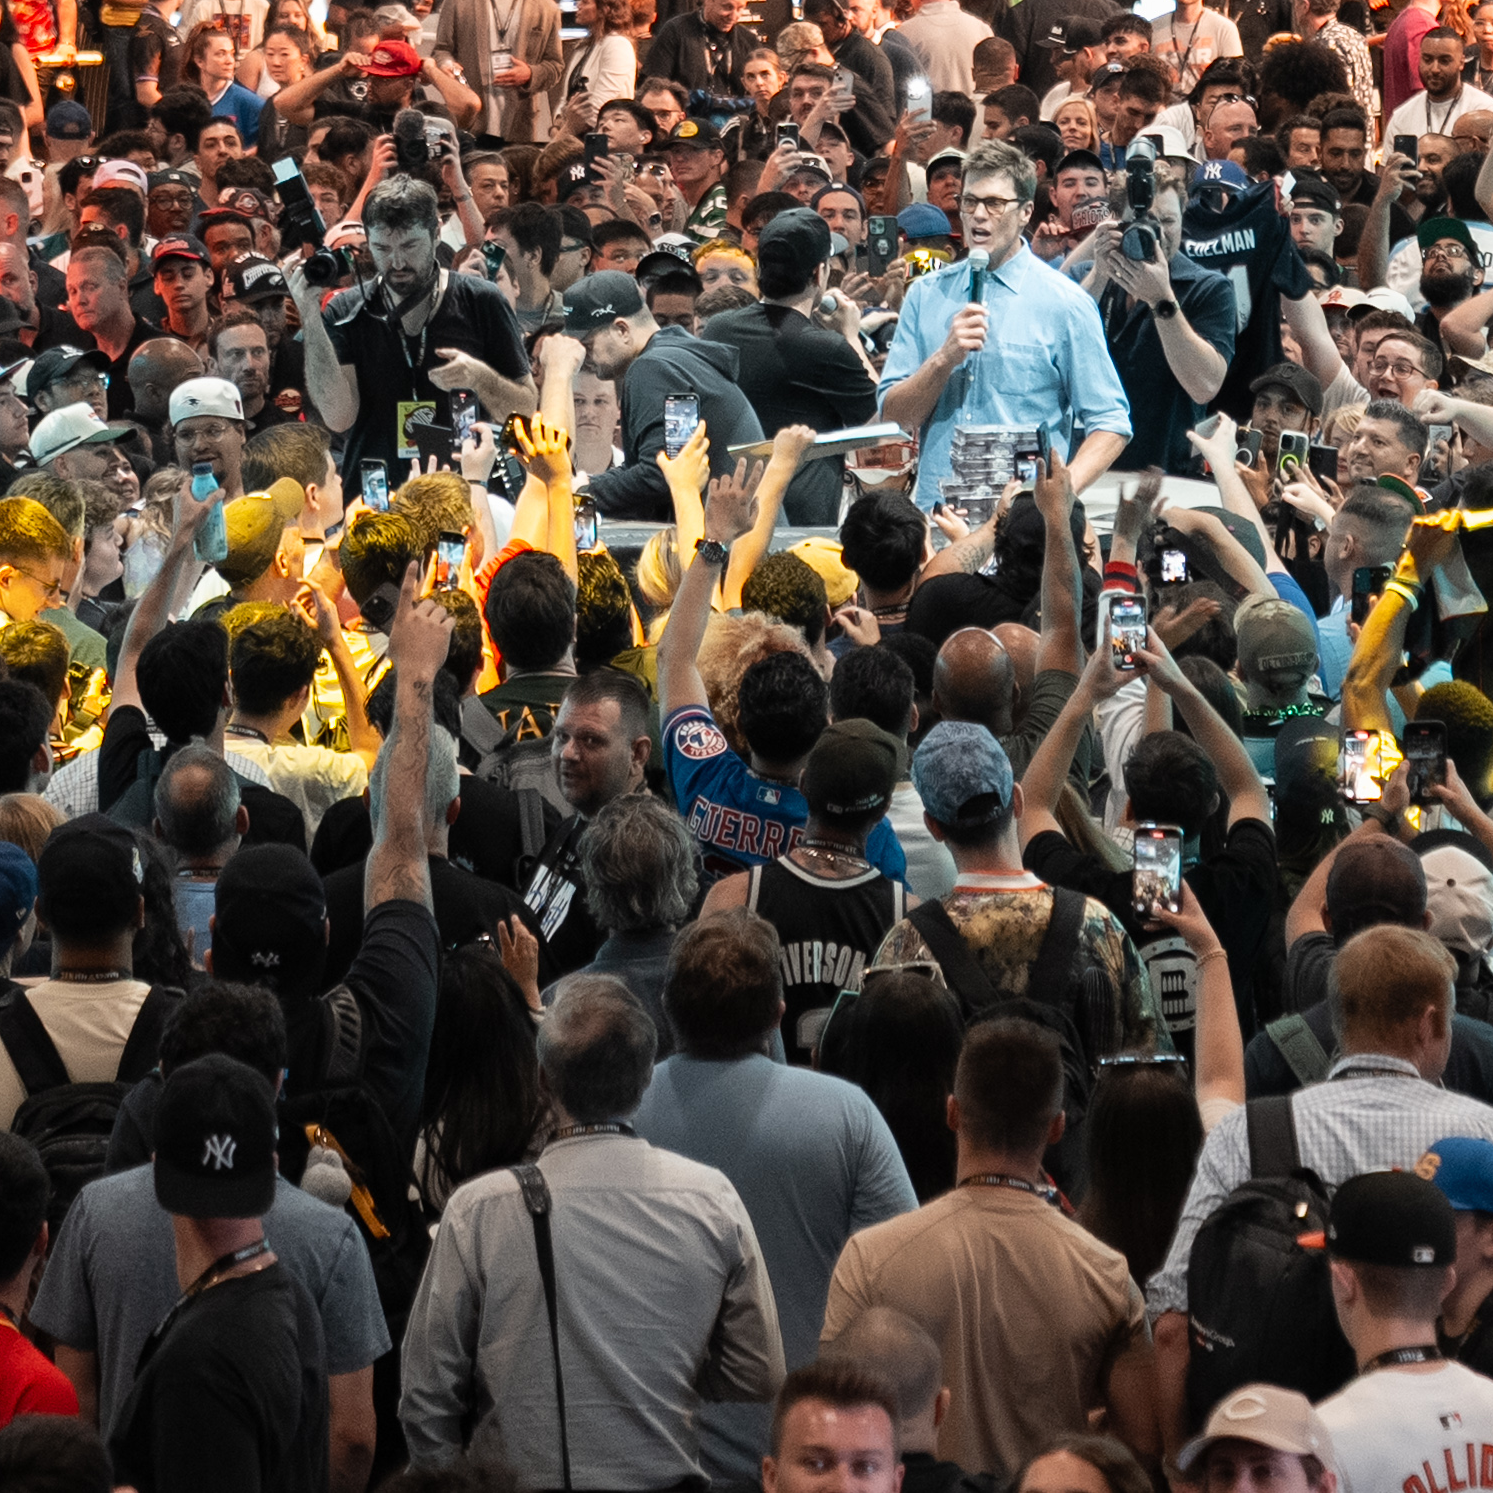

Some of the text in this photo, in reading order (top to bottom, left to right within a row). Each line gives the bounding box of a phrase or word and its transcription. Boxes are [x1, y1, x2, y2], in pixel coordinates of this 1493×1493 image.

[570, 165, 586, 181] NY
[1203, 161, 1223, 181] NY
[1185, 228, 1256, 258] EDELMAN
[203, 1133, 237, 1171] NY
[1225, 1390, 1267, 1421] C
